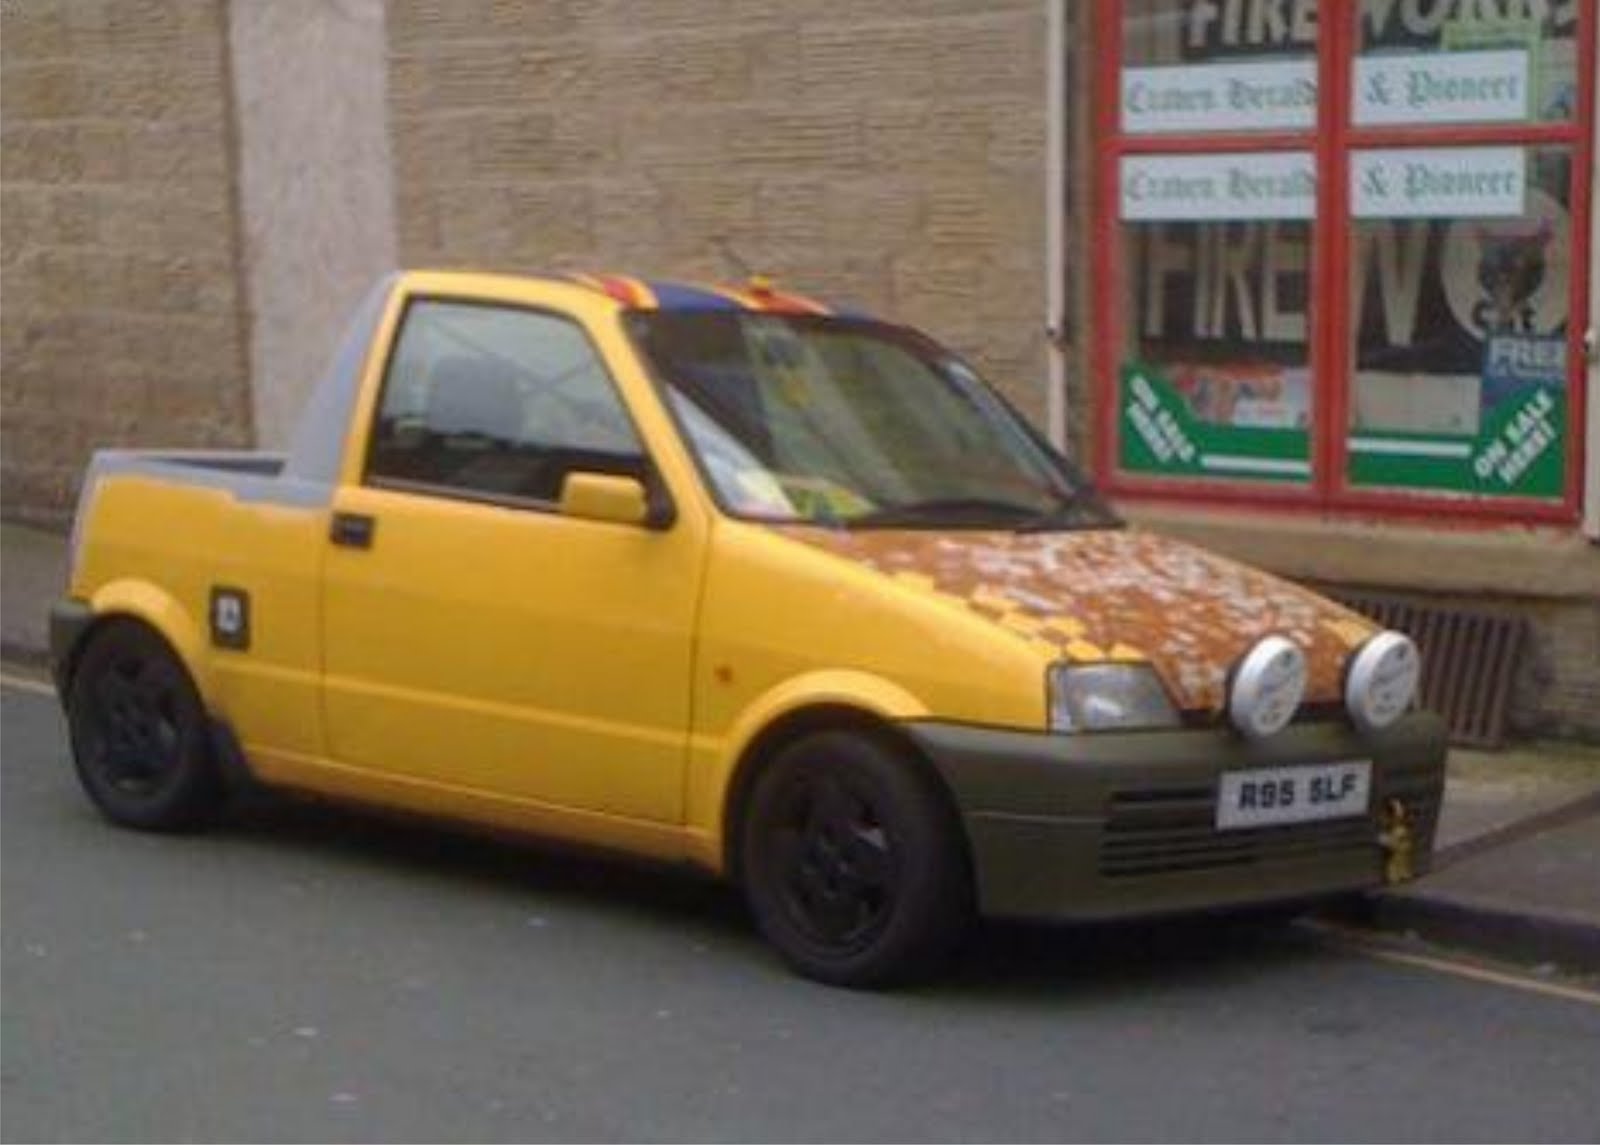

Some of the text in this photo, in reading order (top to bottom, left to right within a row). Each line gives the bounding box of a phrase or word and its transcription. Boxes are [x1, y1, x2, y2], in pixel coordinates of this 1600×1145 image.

[1366, 68, 1520, 109] & Pioneer
[1362, 162, 1516, 200] & Pioneer
[1474, 388, 1554, 479] ON SALE
